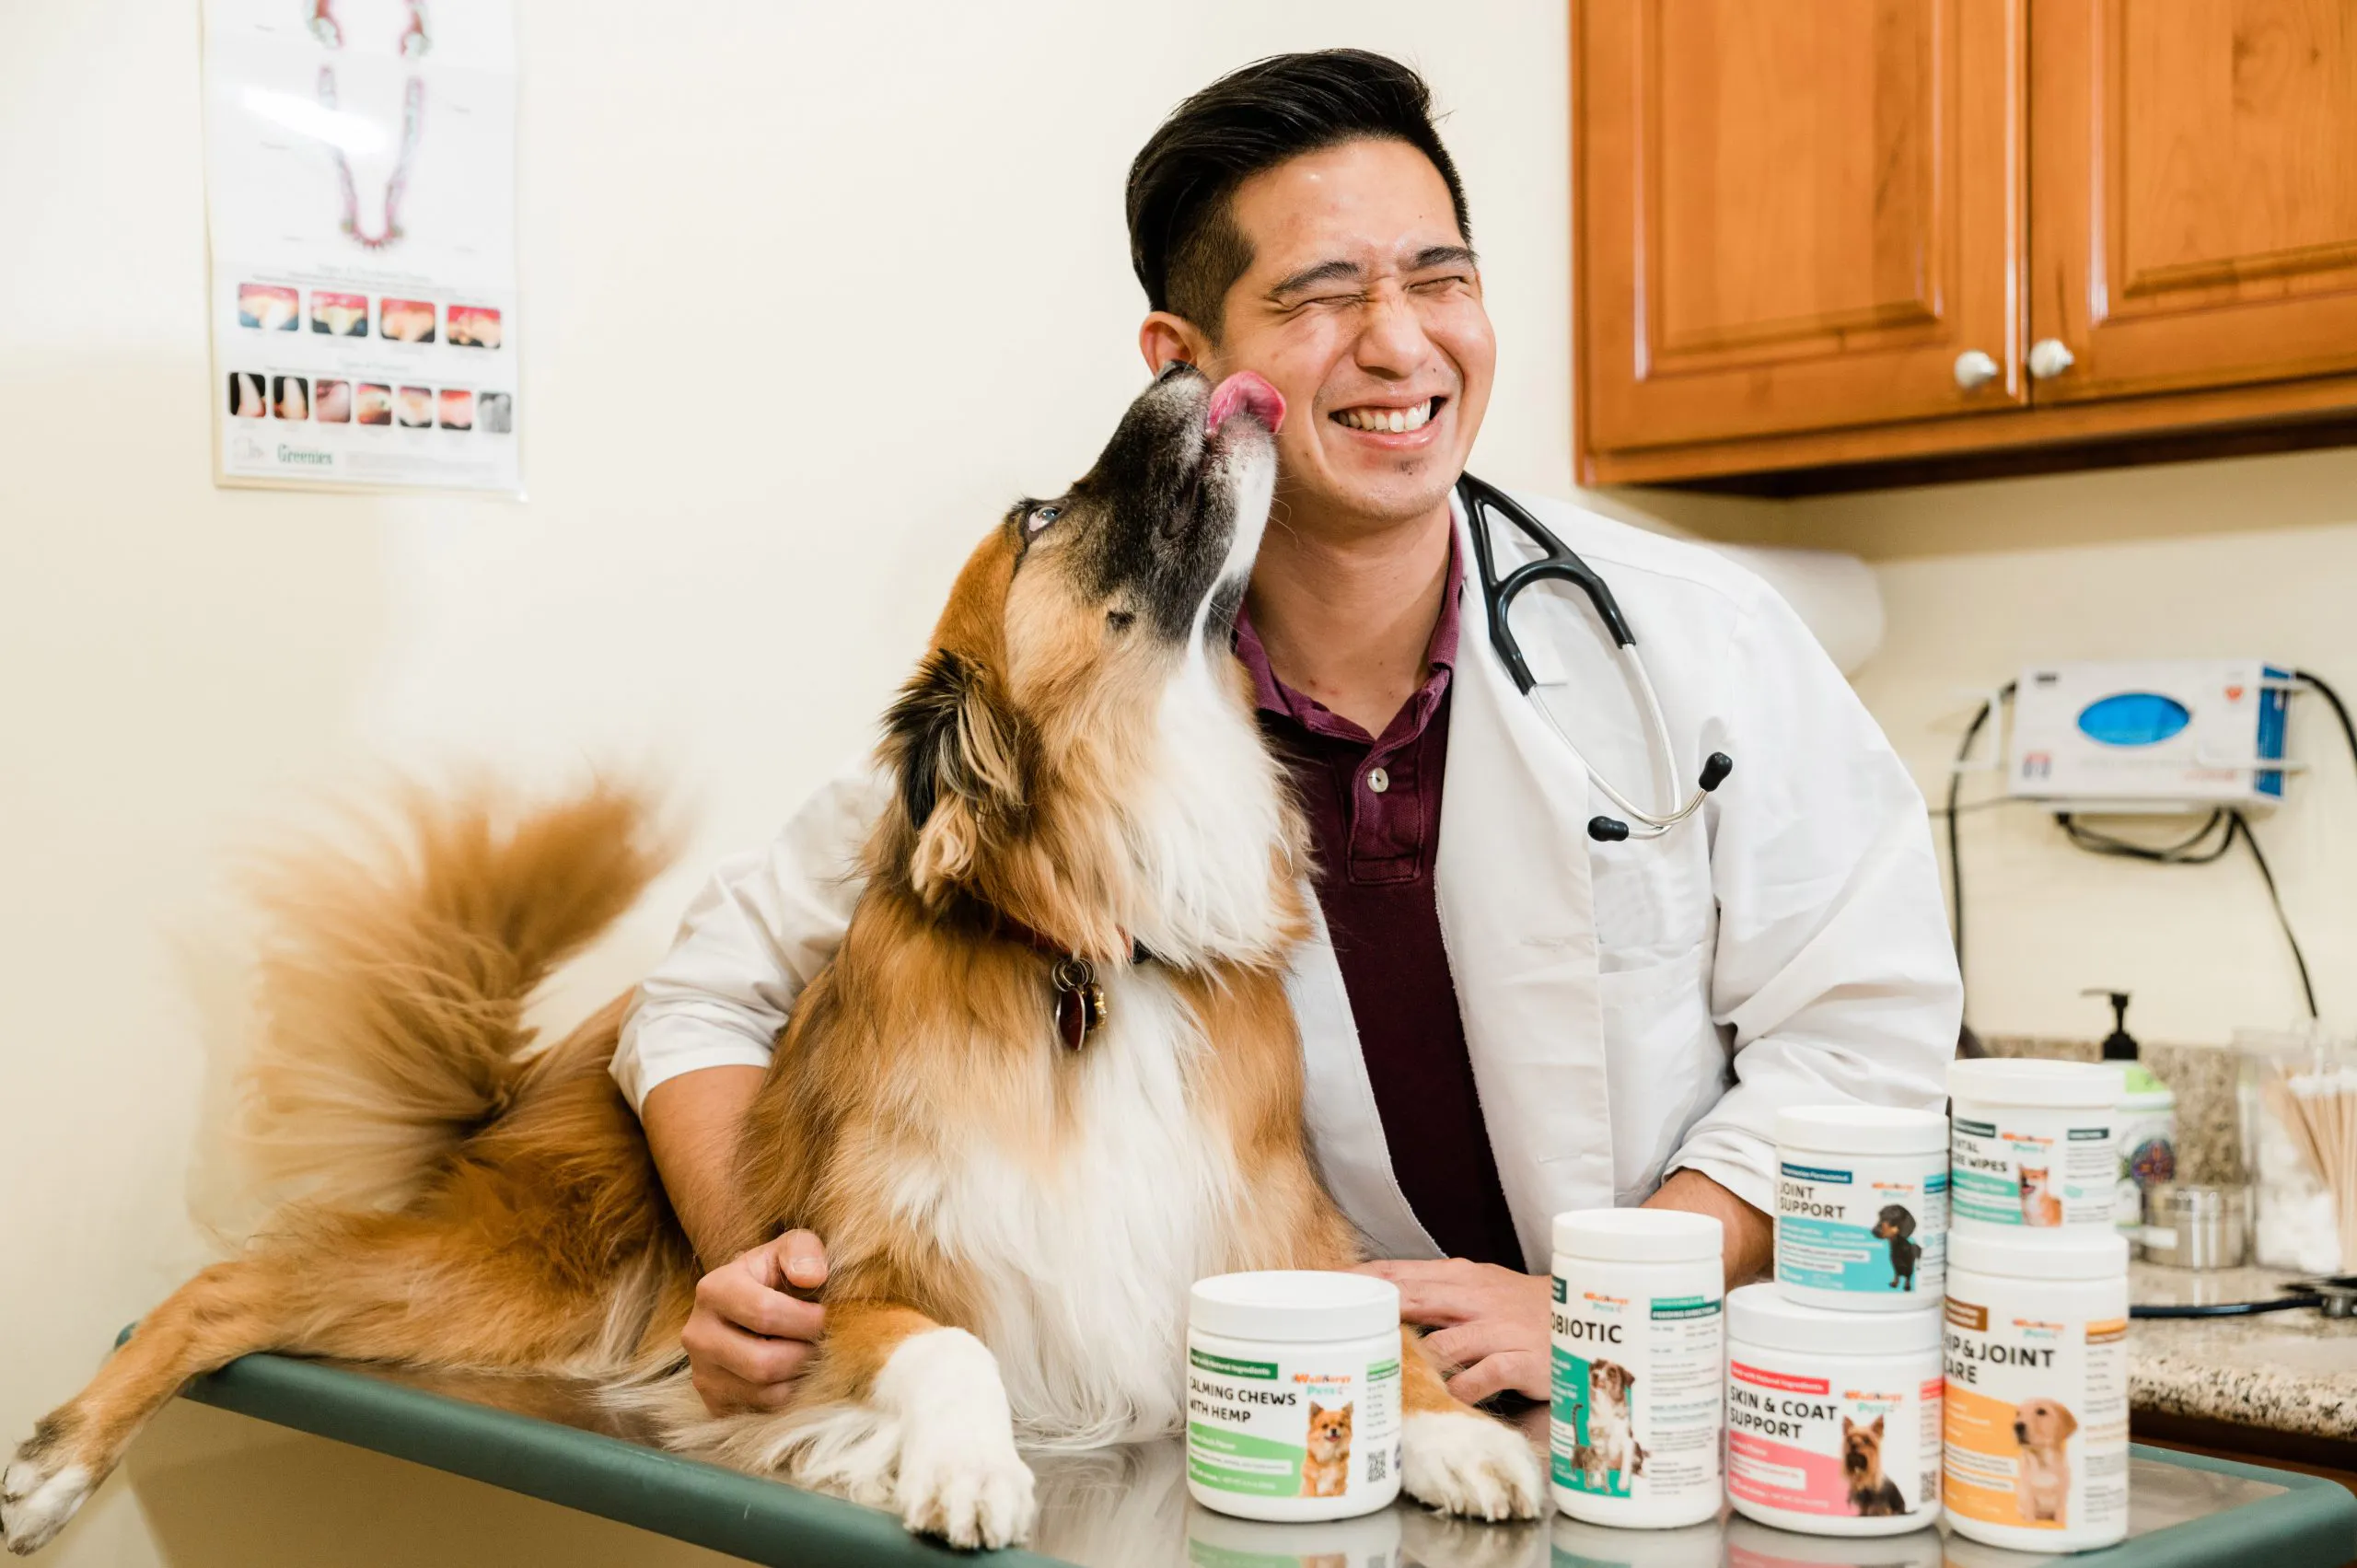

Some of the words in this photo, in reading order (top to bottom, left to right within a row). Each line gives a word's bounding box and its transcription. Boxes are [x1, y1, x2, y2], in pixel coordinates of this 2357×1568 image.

[277, 443, 334, 466] Greenies
[1969, 1158, 2008, 1172] WIPES
[1781, 1181, 1815, 1199] JOINT
[1781, 1197, 1846, 1219] SUPPORT
[1238, 1389, 1296, 1406] CHEWS
[1730, 1386, 1759, 1410] SKIN
[1764, 1397, 1775, 1413] &
[1782, 1400, 1838, 1421] COAT
[1212, 1406, 1252, 1423] HEMP
[1730, 1407, 1803, 1440] SUPPORT
